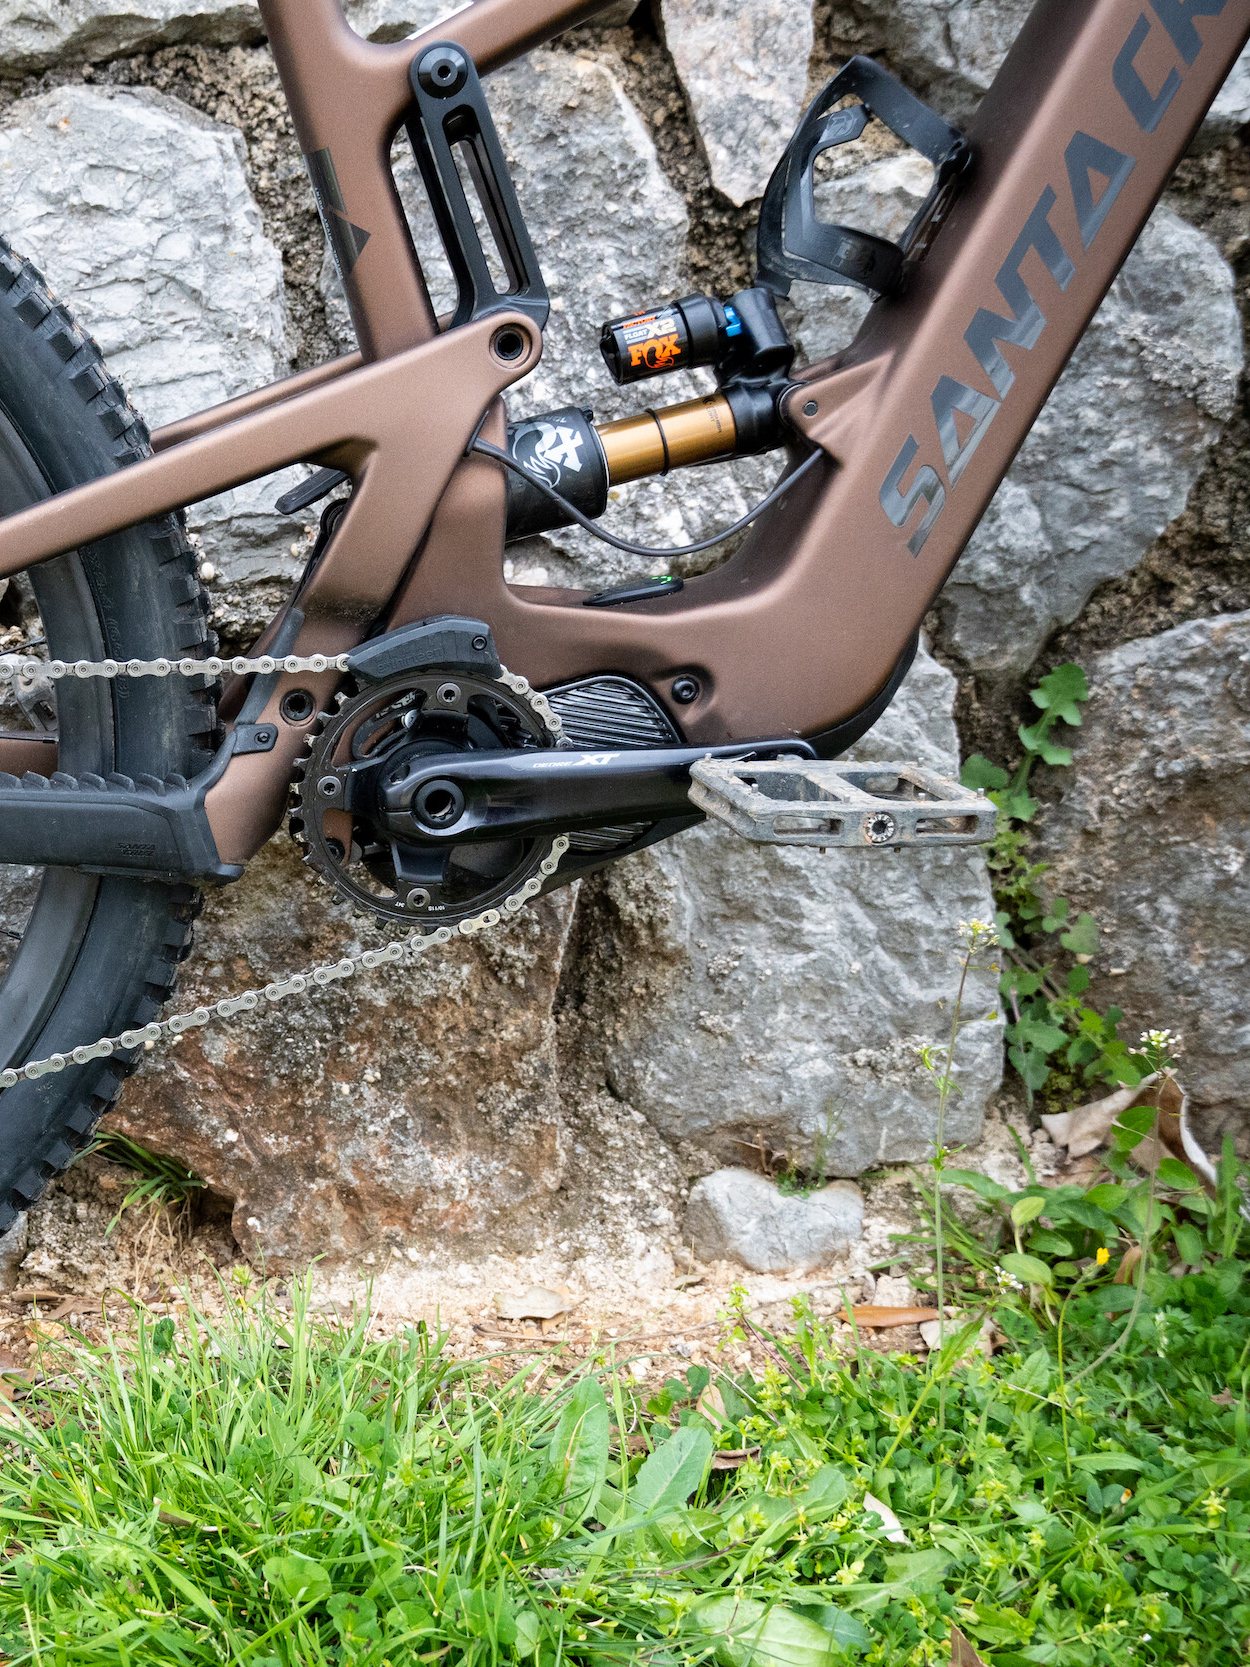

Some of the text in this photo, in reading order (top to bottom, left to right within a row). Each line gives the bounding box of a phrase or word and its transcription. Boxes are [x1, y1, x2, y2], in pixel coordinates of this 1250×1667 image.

[624, 318, 677, 340] FLOAT X2
[628, 333, 681, 368] FOX
[879, 130, 1136, 558] SANTA
[532, 753, 621, 769] DEORE XT
